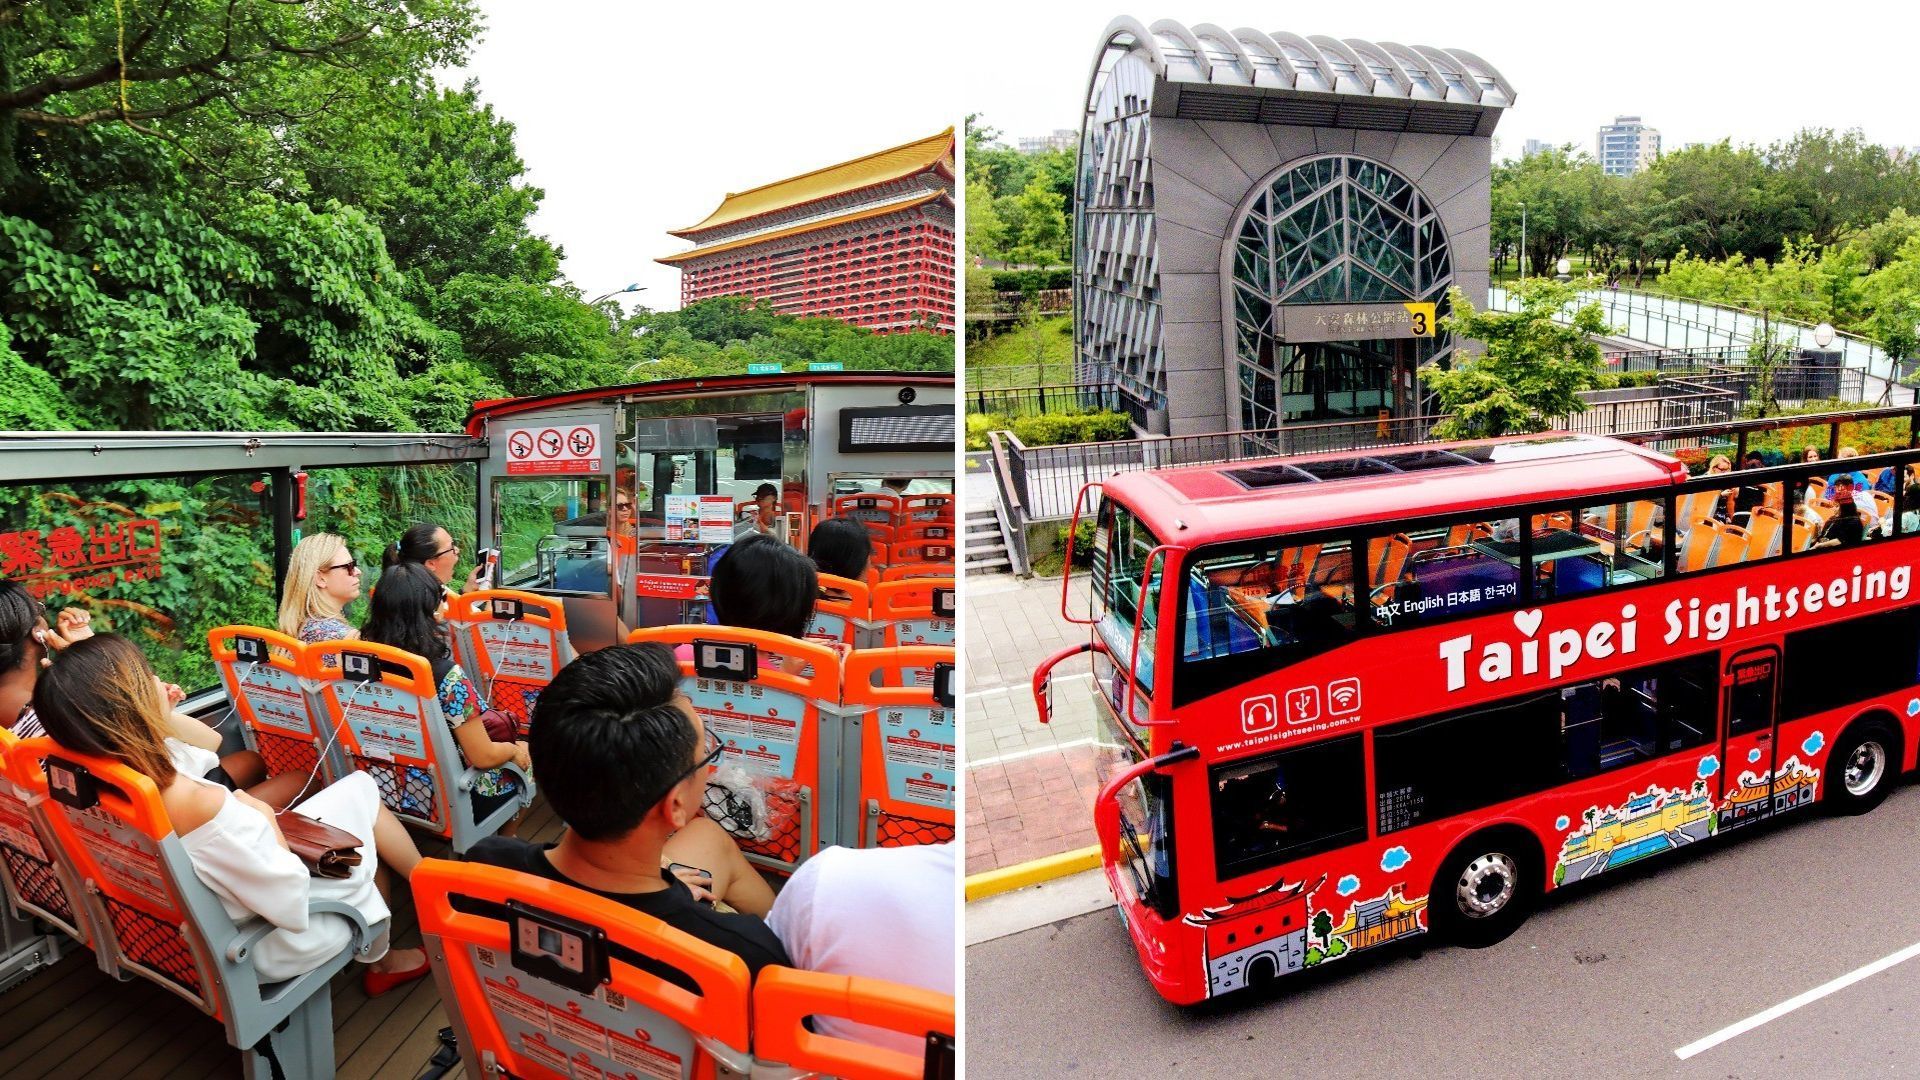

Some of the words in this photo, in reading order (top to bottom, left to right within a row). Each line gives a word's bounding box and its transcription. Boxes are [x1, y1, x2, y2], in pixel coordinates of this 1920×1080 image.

[1412, 312, 1427, 335] 3
[0, 519, 161, 574] 緊急出口
[26, 572, 117, 599] ergency
[124, 563, 162, 583] exit
[1376, 602, 1401, 618] 中文
[1404, 594, 1444, 613] English
[1447, 588, 1480, 607] 日本語
[1484, 582, 1517, 600] 한국어
[1439, 604, 1637, 692] Taipei
[1663, 565, 1911, 645] Sightseeing
[1216, 715, 1361, 752] www.taipeisightseeing.com.tw
